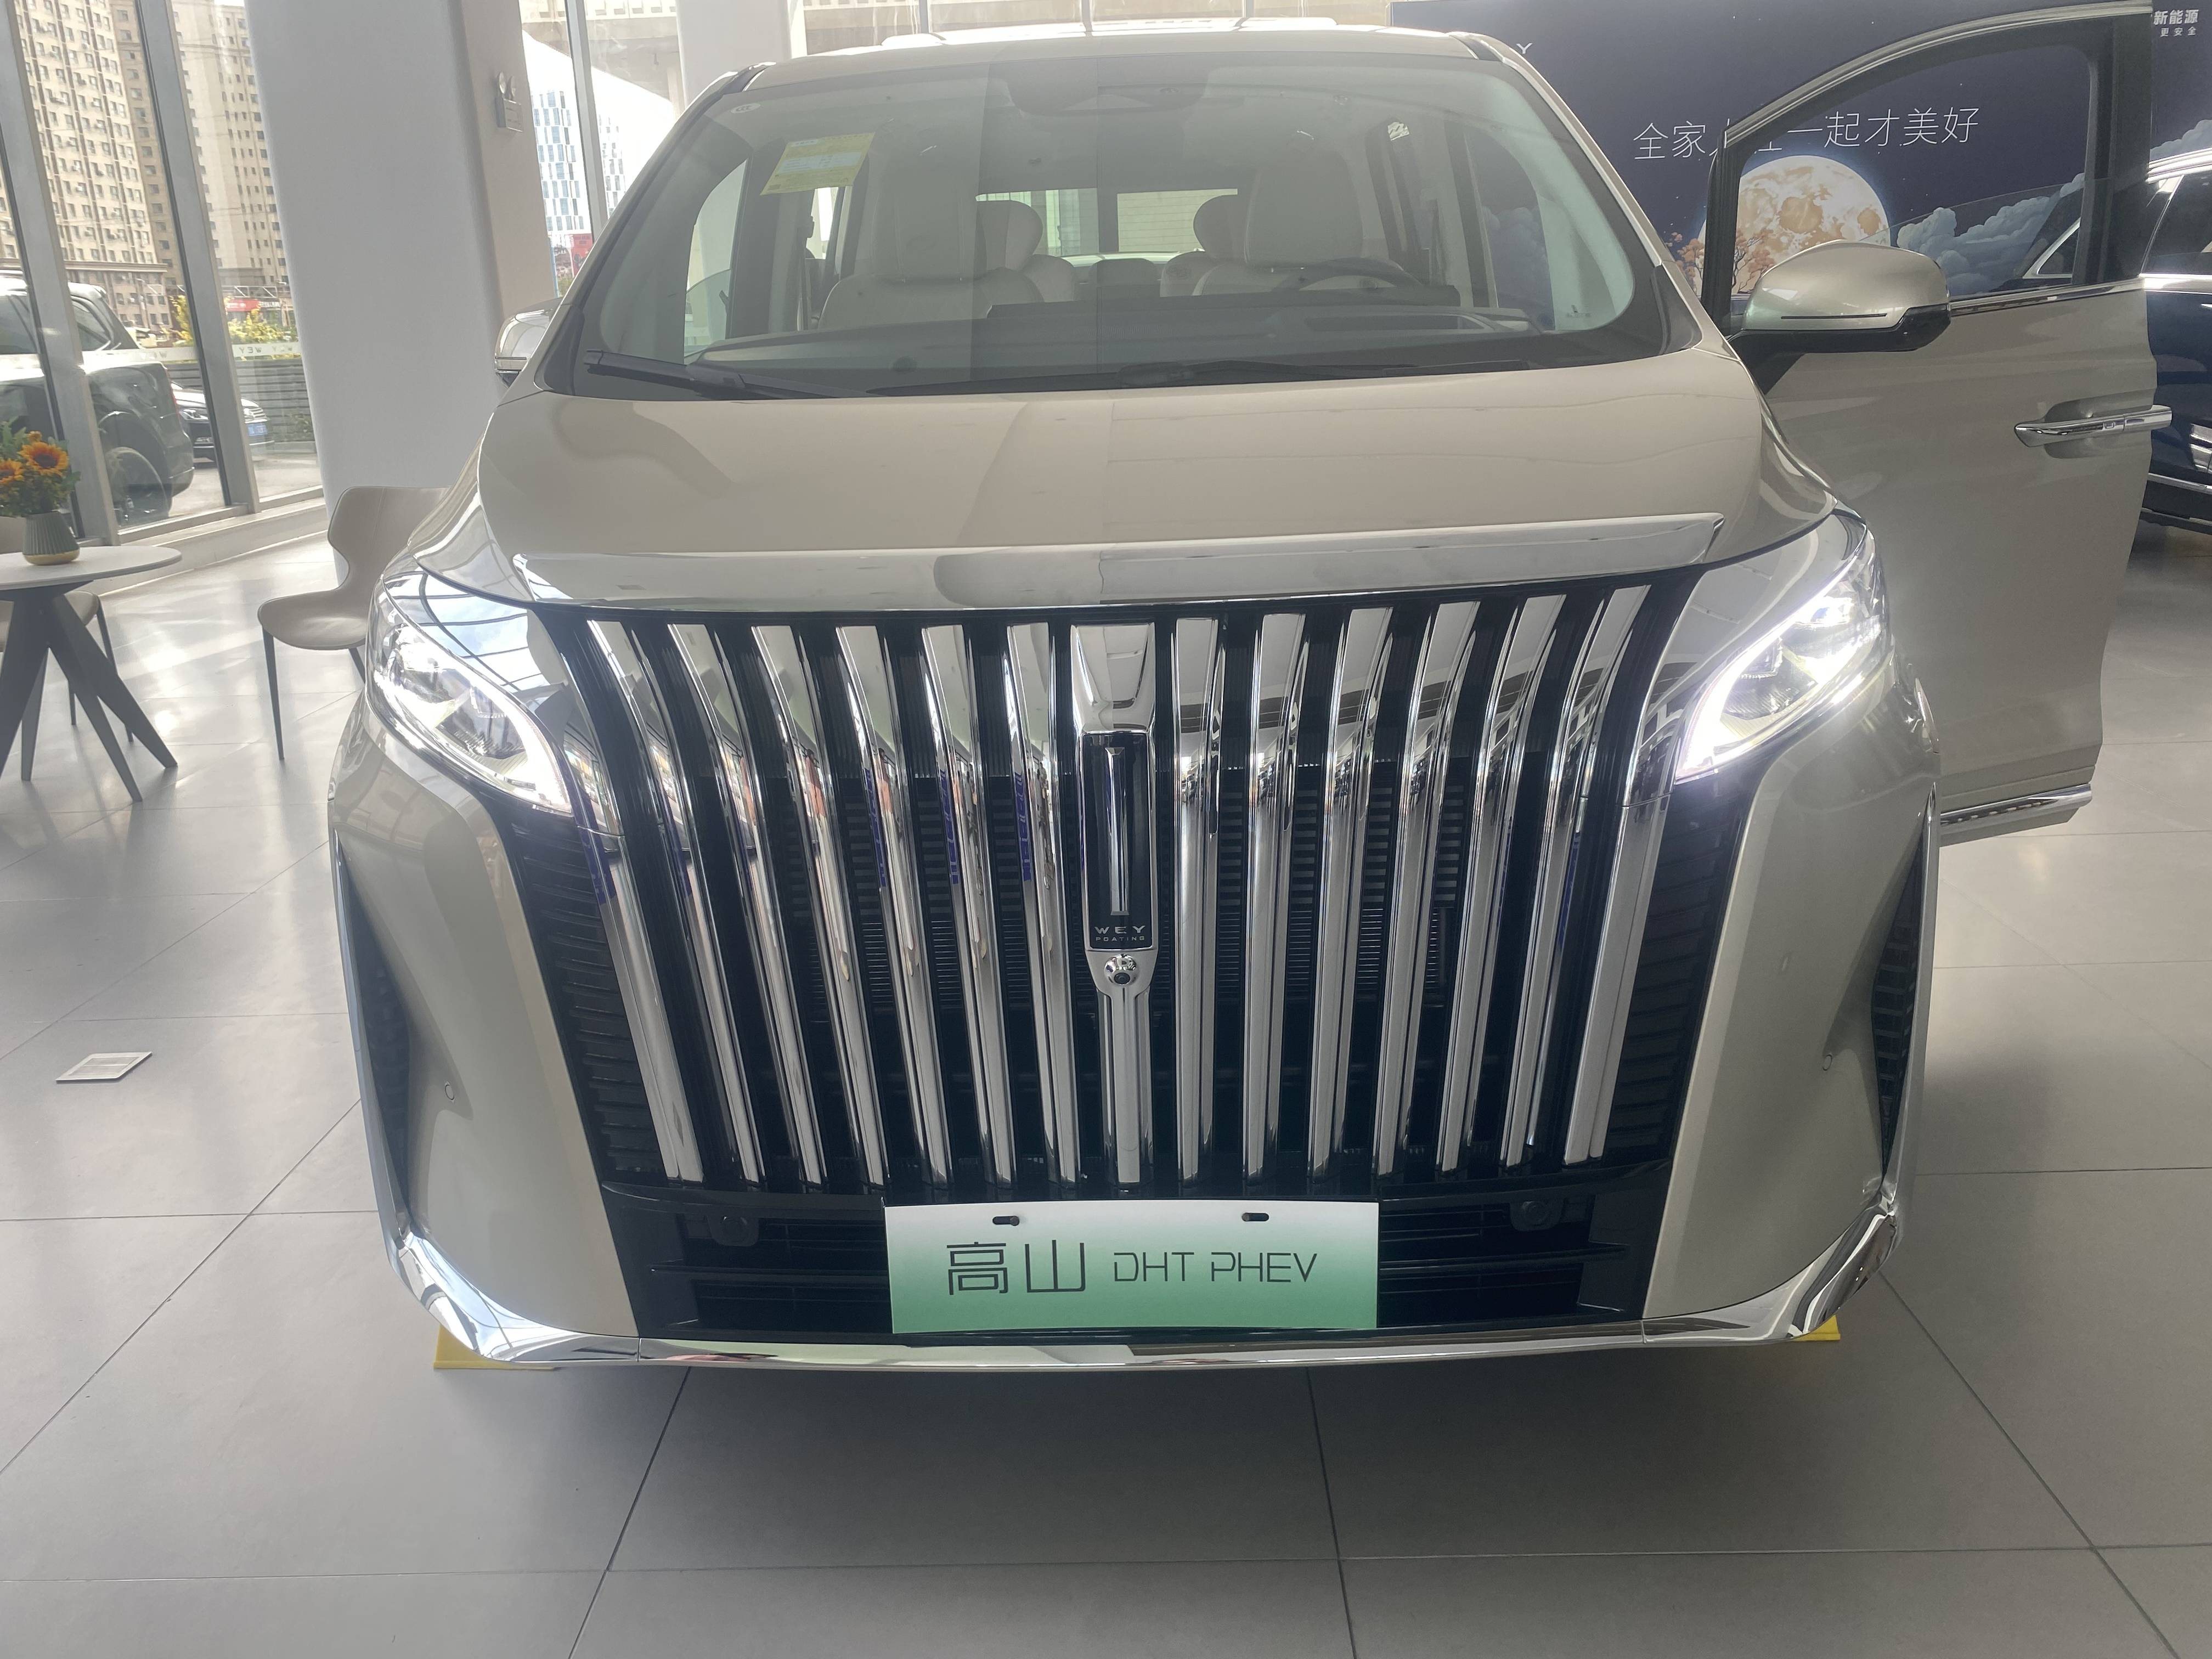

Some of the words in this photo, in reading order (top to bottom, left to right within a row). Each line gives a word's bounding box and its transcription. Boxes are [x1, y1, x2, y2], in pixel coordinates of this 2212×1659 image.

[2153, 9, 2199, 25] 新能源
[2160, 26, 2197, 37] 更安全
[1633, 106, 1979, 160] 全家一起才美好
[1094, 925, 1146, 934] WEY
[946, 1239, 1086, 1295] 高山
[1114, 1251, 1195, 1282] DHT
[1211, 1252, 1317, 1283] PHEV
